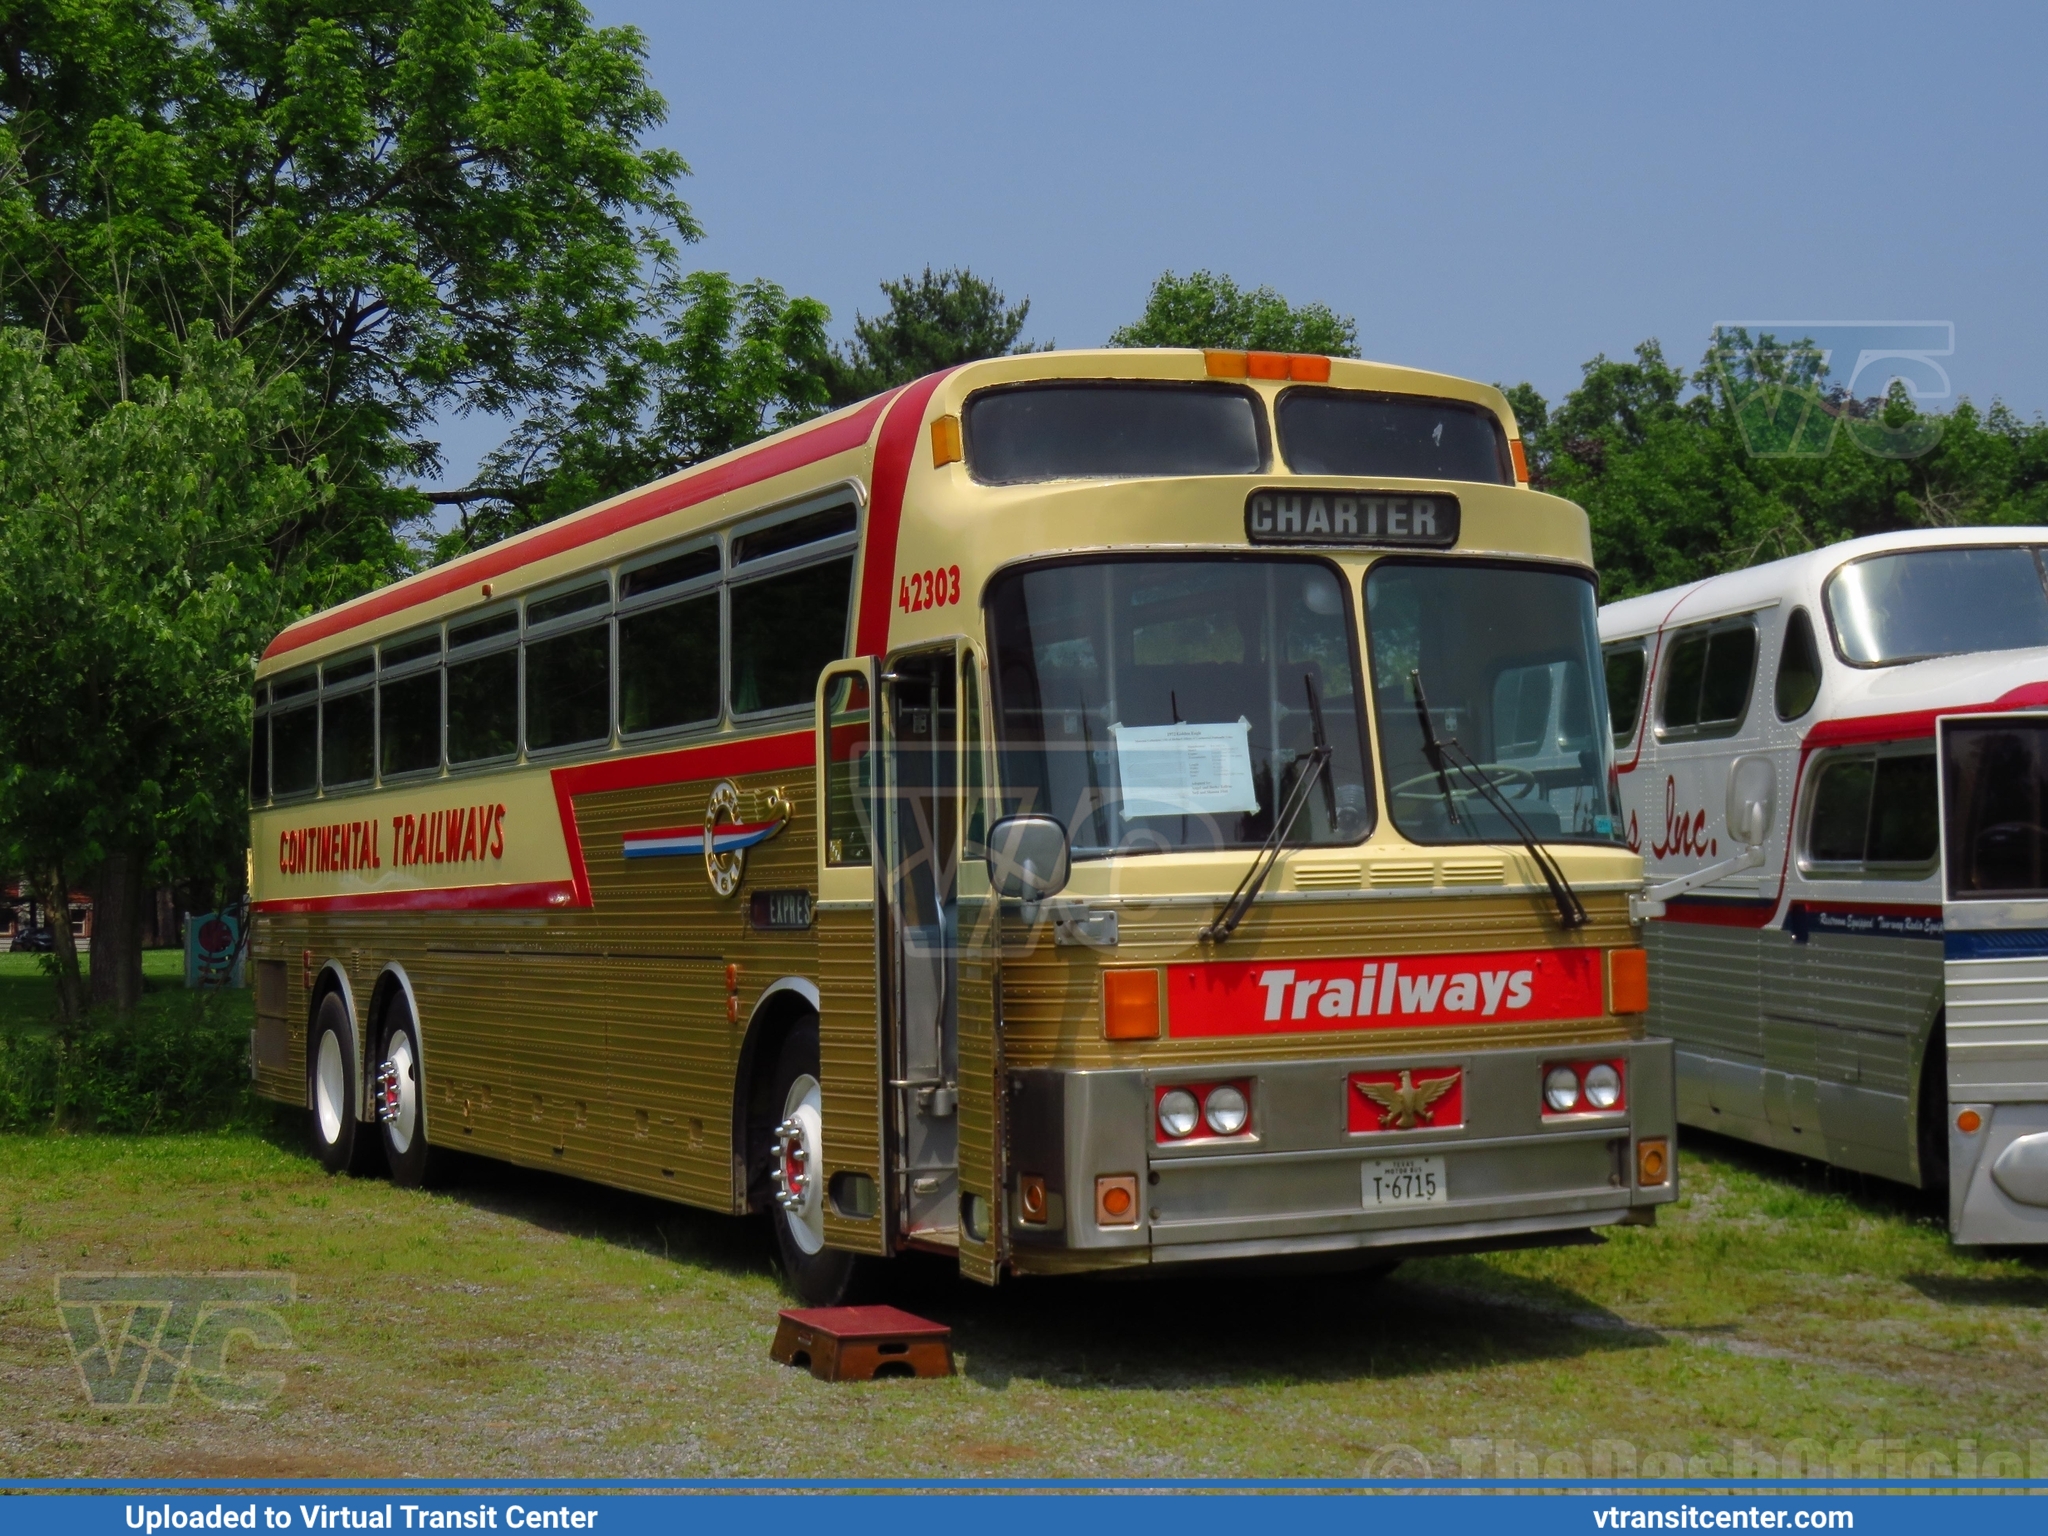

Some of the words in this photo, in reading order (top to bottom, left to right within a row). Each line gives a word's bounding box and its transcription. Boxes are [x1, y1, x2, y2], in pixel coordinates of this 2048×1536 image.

[1251, 494, 1438, 537] CHARTER
[898, 564, 961, 614] 42303
[279, 818, 381, 875] CONTINENTAL
[392, 803, 507, 868] TRAILWAYS
[1257, 962, 1534, 1022] Trailways
